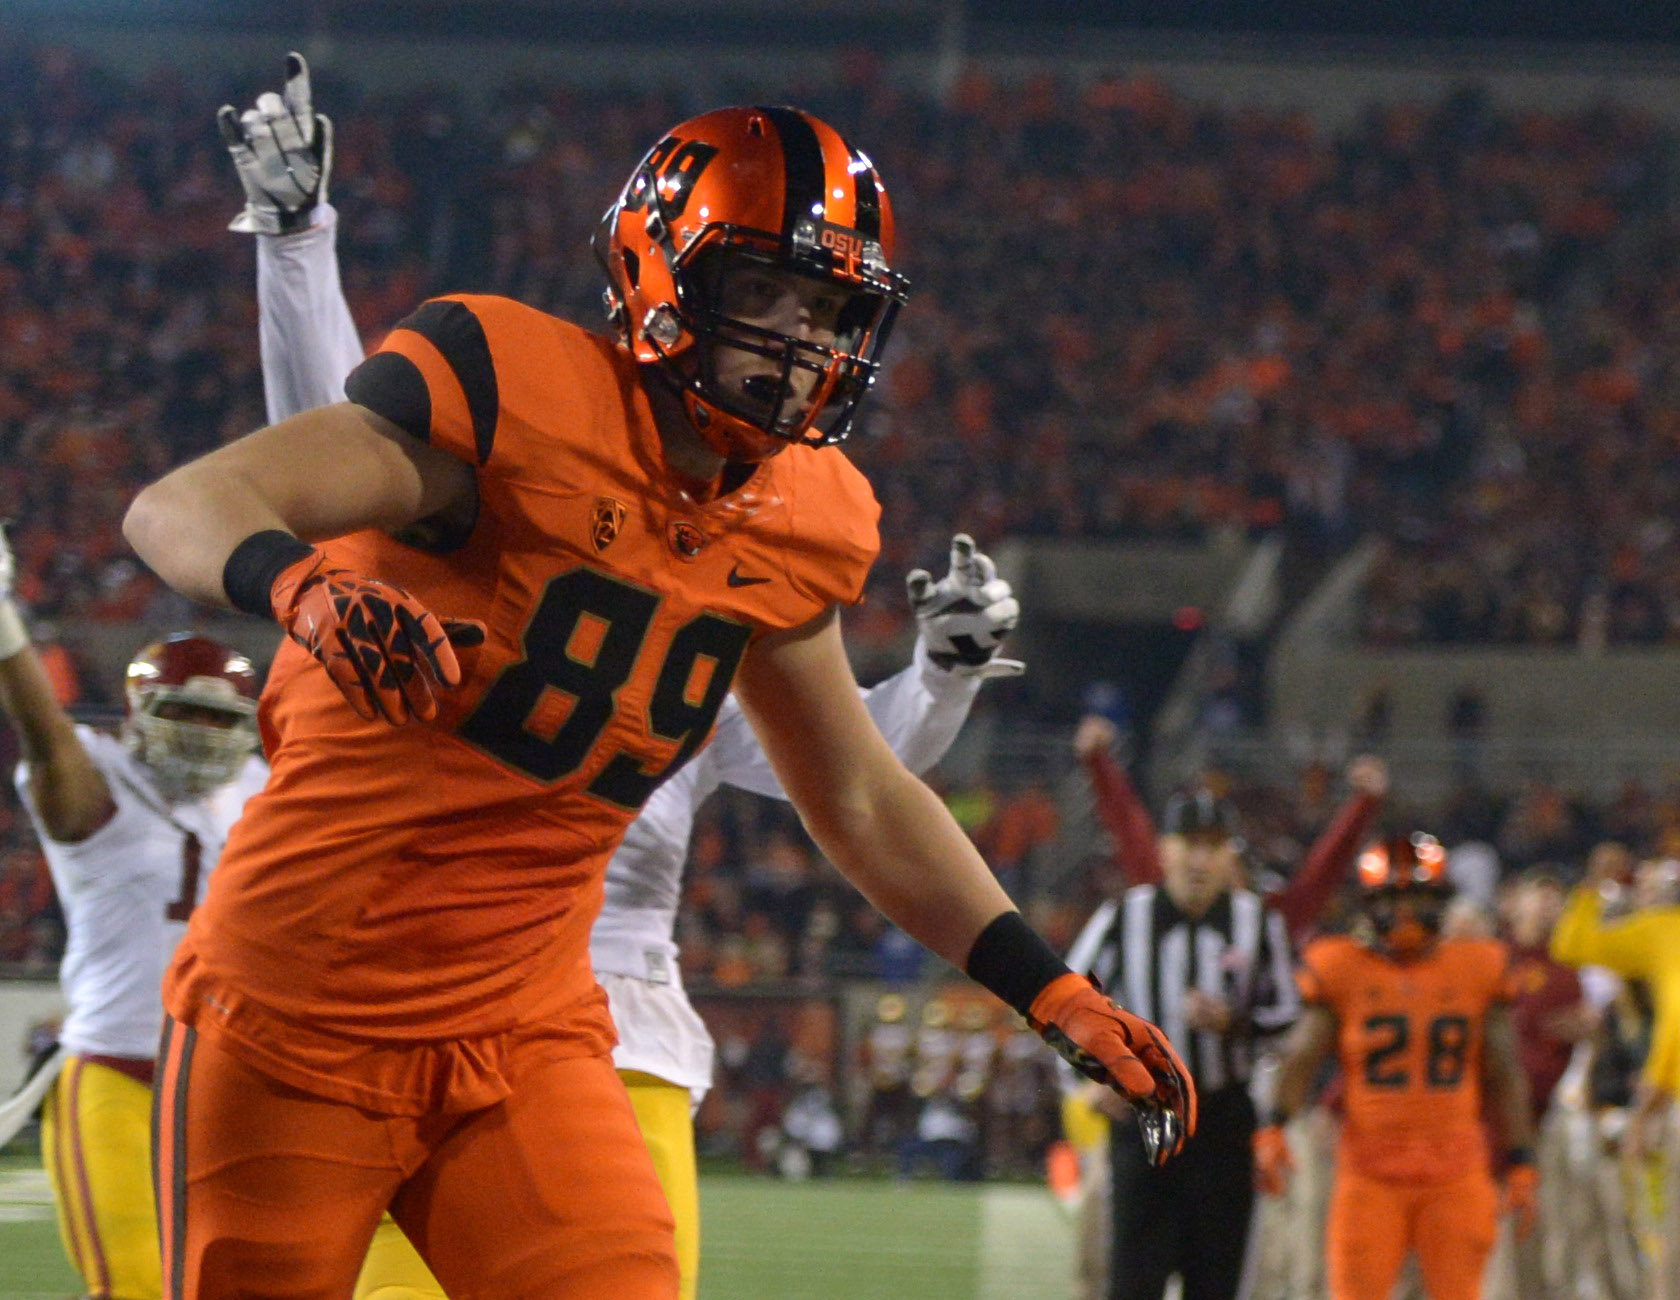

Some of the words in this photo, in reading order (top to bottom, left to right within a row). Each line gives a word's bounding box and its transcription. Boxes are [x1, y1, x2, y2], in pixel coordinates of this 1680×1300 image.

[821, 229, 862, 257] OSU
[456, 564, 756, 812] 89
[1364, 1015, 1470, 1087] 28
